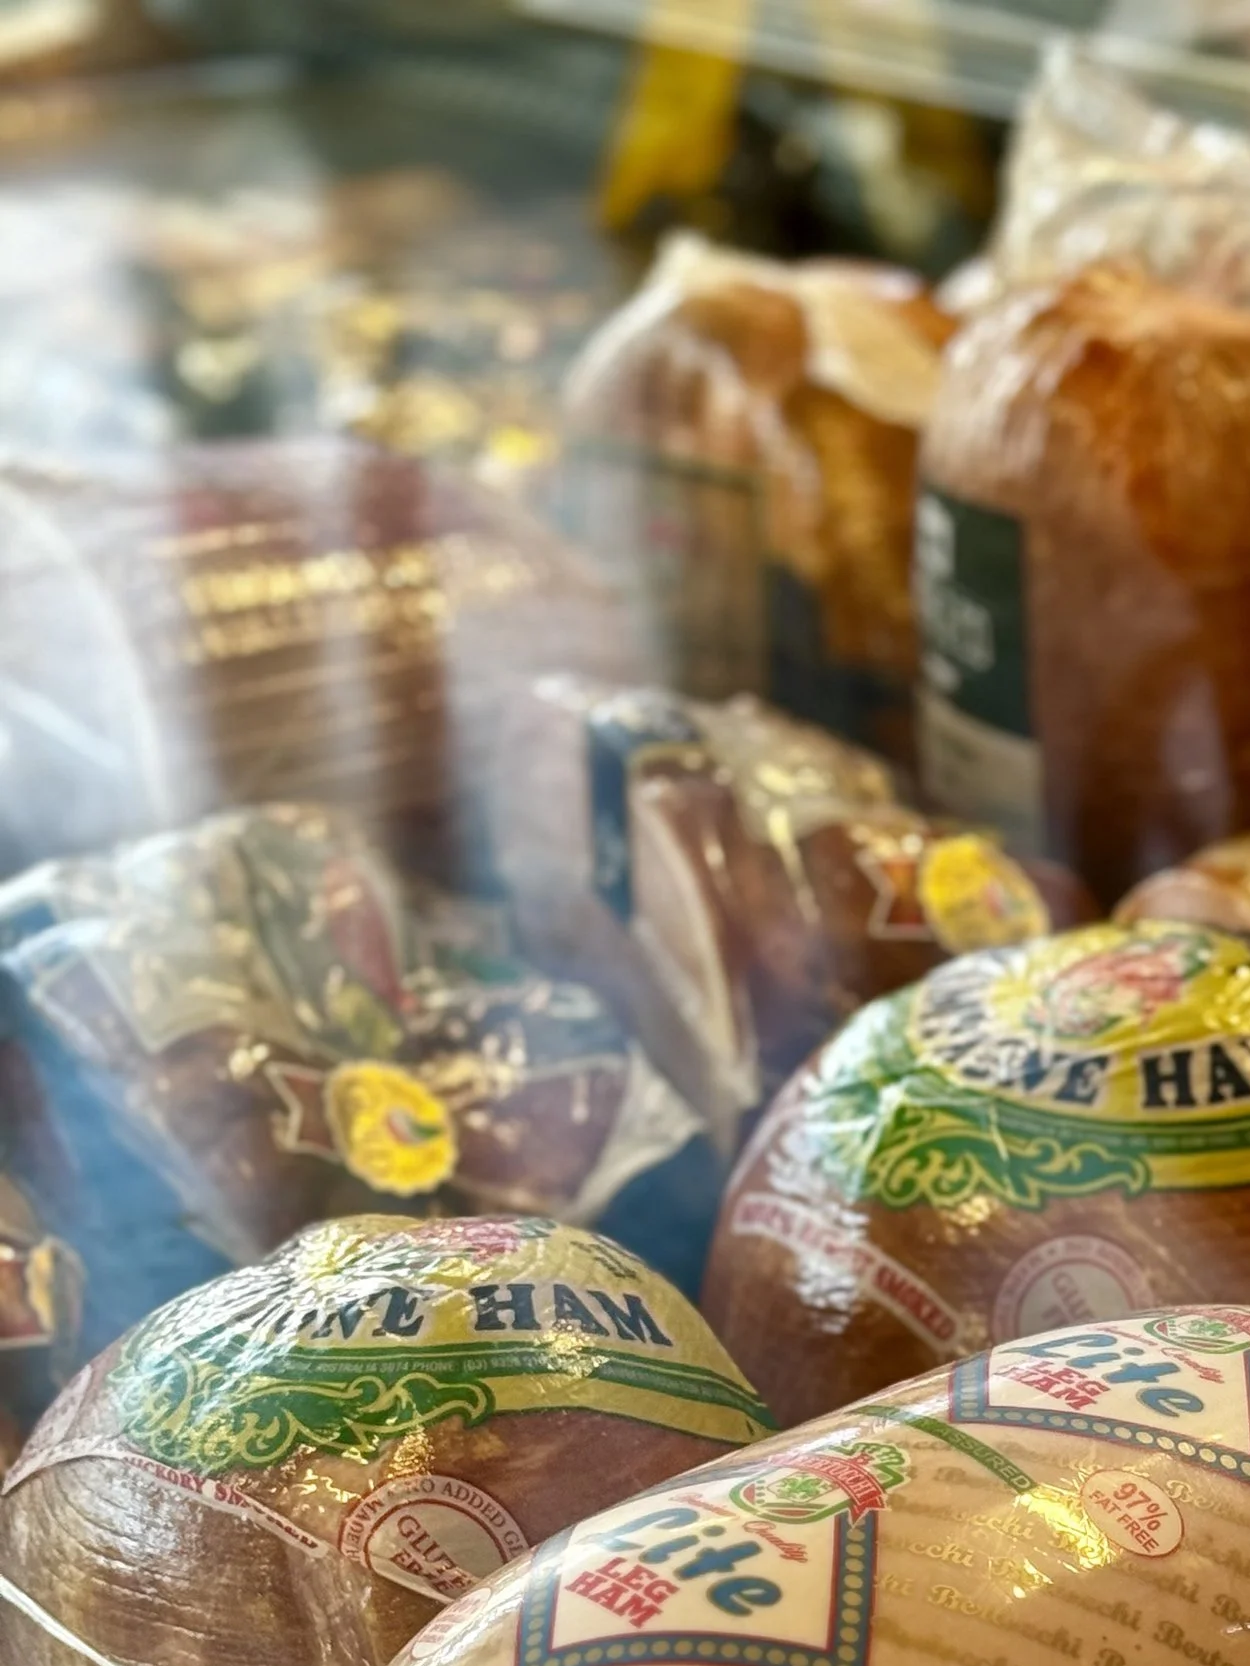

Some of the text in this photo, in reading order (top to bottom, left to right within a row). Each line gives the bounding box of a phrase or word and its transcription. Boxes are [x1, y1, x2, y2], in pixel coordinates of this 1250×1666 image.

[469, 1282, 676, 1348] HAM
[994, 1363, 1101, 1411] HAM
[996, 1332, 1205, 1417] Lite
[1033, 1359, 1111, 1397] LEG
[933, 1422, 1033, 1490] ASSURED
[440, 1480, 506, 1528] ADDED
[1088, 1489, 1160, 1553] FAT FREE
[1113, 1482, 1169, 1532] 97%
[577, 1507, 783, 1616] Lite
[742, 1519, 808, 1564] Quality
[565, 1571, 664, 1629] HAM
[596, 1556, 681, 1605] LEG
